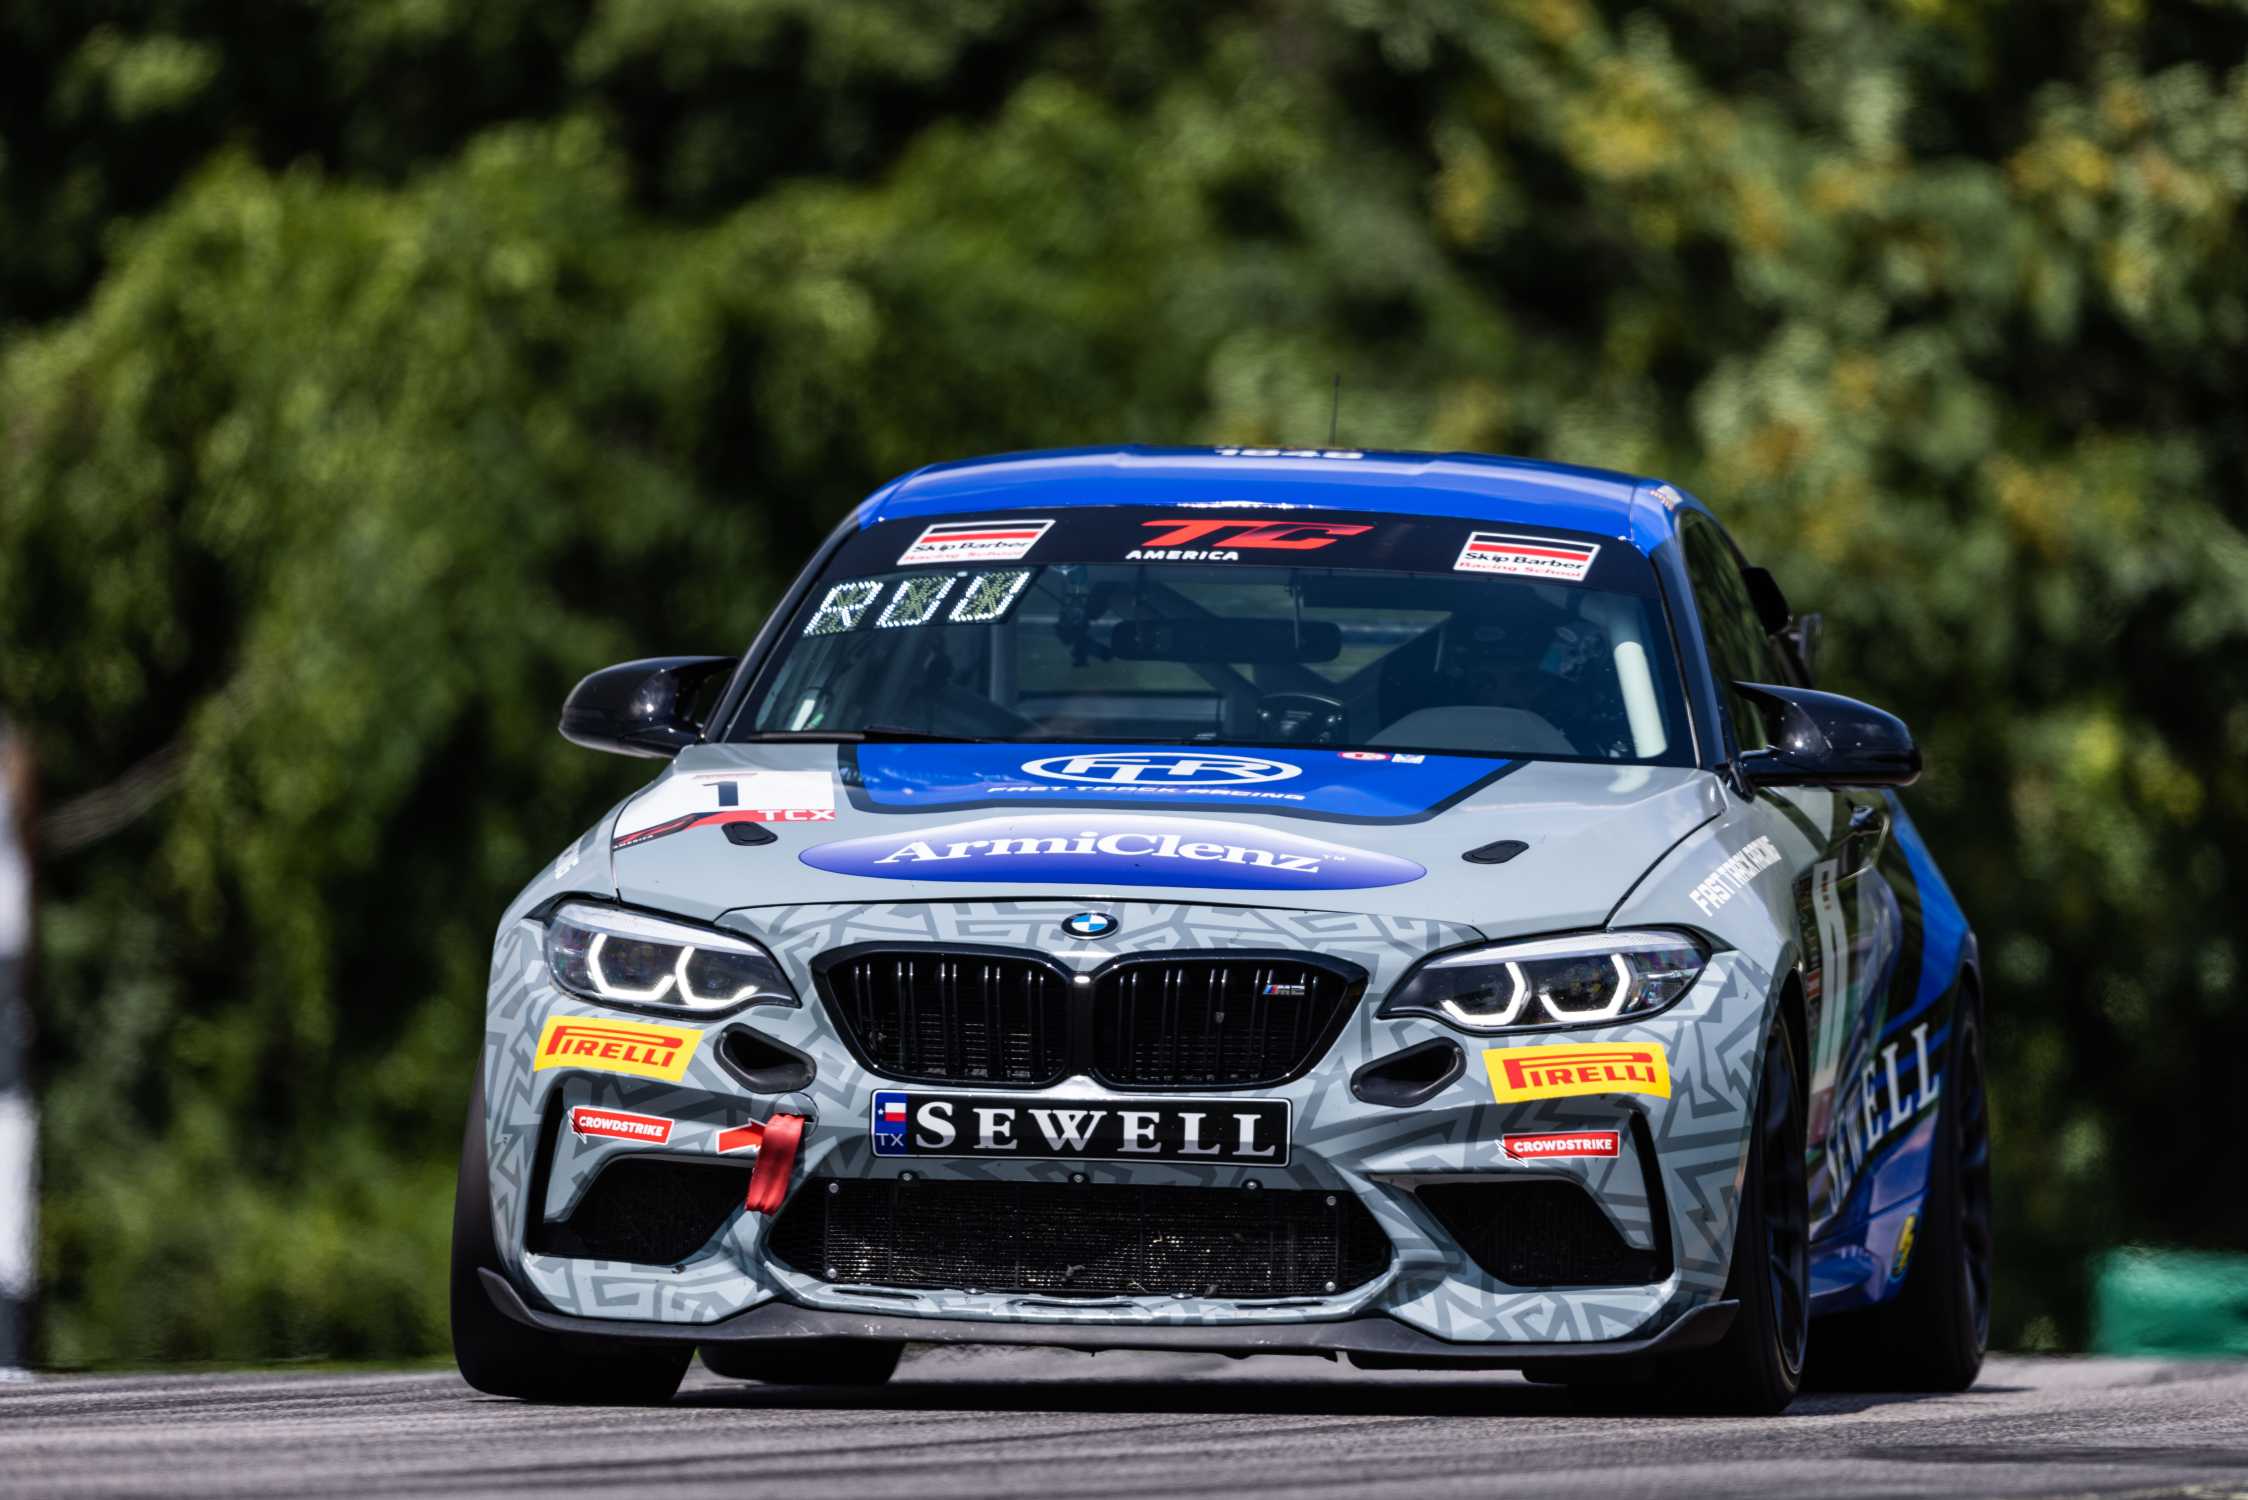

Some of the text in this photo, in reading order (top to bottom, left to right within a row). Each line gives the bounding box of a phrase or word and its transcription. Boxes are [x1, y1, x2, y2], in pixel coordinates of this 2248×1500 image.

[1125, 549, 1239, 561] AMERICA
[1465, 552, 1585, 570] Skip Barber
[703, 781, 739, 807] 1
[758, 809, 836, 821] TCX
[873, 831, 1320, 873] ArmiClenz
[1689, 872, 1735, 917] FAST
[545, 1025, 684, 1068] PIRELLI
[1502, 1052, 1656, 1090] PIRELLI
[578, 1114, 665, 1138] CROWDSTRIKE
[915, 1101, 1276, 1156] SEWELL
[876, 1132, 904, 1147] TX
[1513, 1138, 1613, 1152] CROWDSTRIKE
